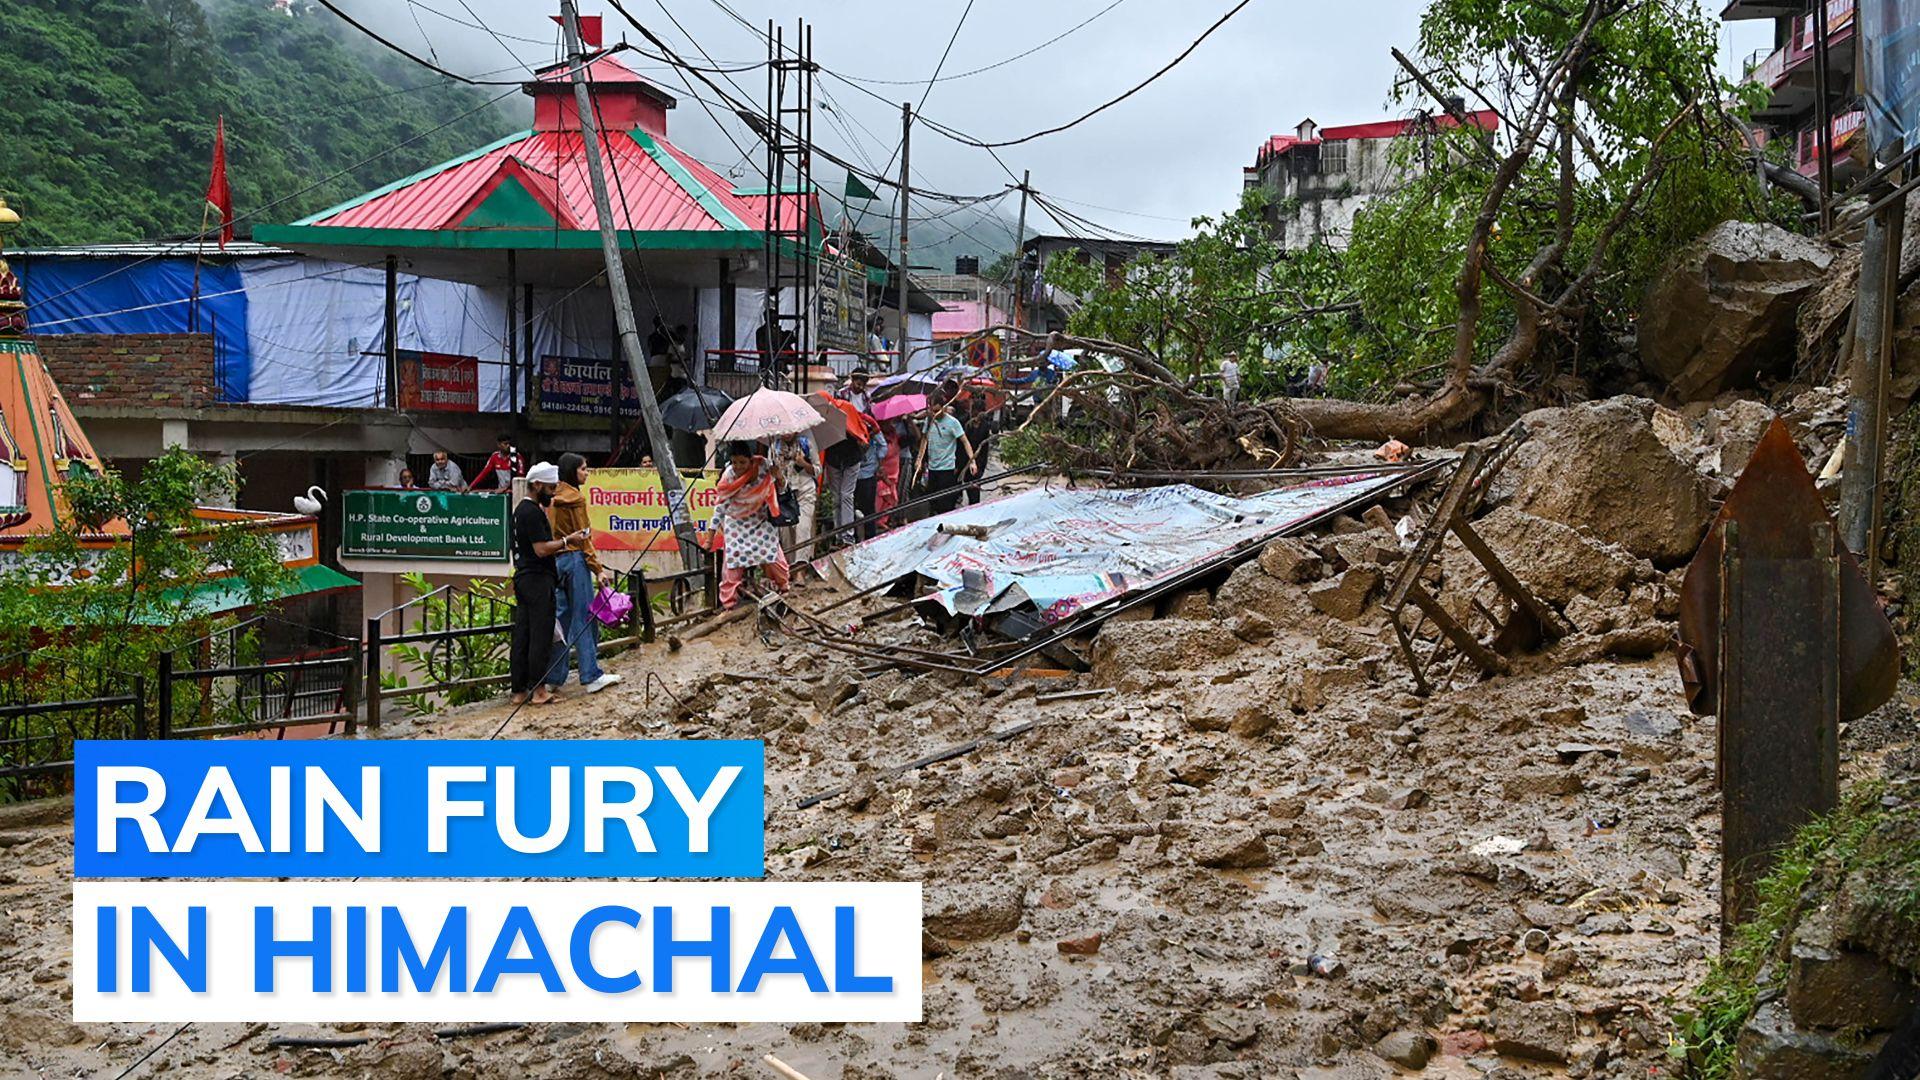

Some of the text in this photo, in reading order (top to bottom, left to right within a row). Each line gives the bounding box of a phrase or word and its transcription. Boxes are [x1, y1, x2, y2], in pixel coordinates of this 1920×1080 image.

[563, 360, 612, 380] कार्याल
[590, 486, 654, 507] विश्वकर्मा
[349, 514, 501, 526] H.P. State Co-operative Agriculture
[609, 515, 640, 531] जिला
[420, 525, 427, 533] &
[361, 533, 487, 544] Rural Development Bank Ltd.
